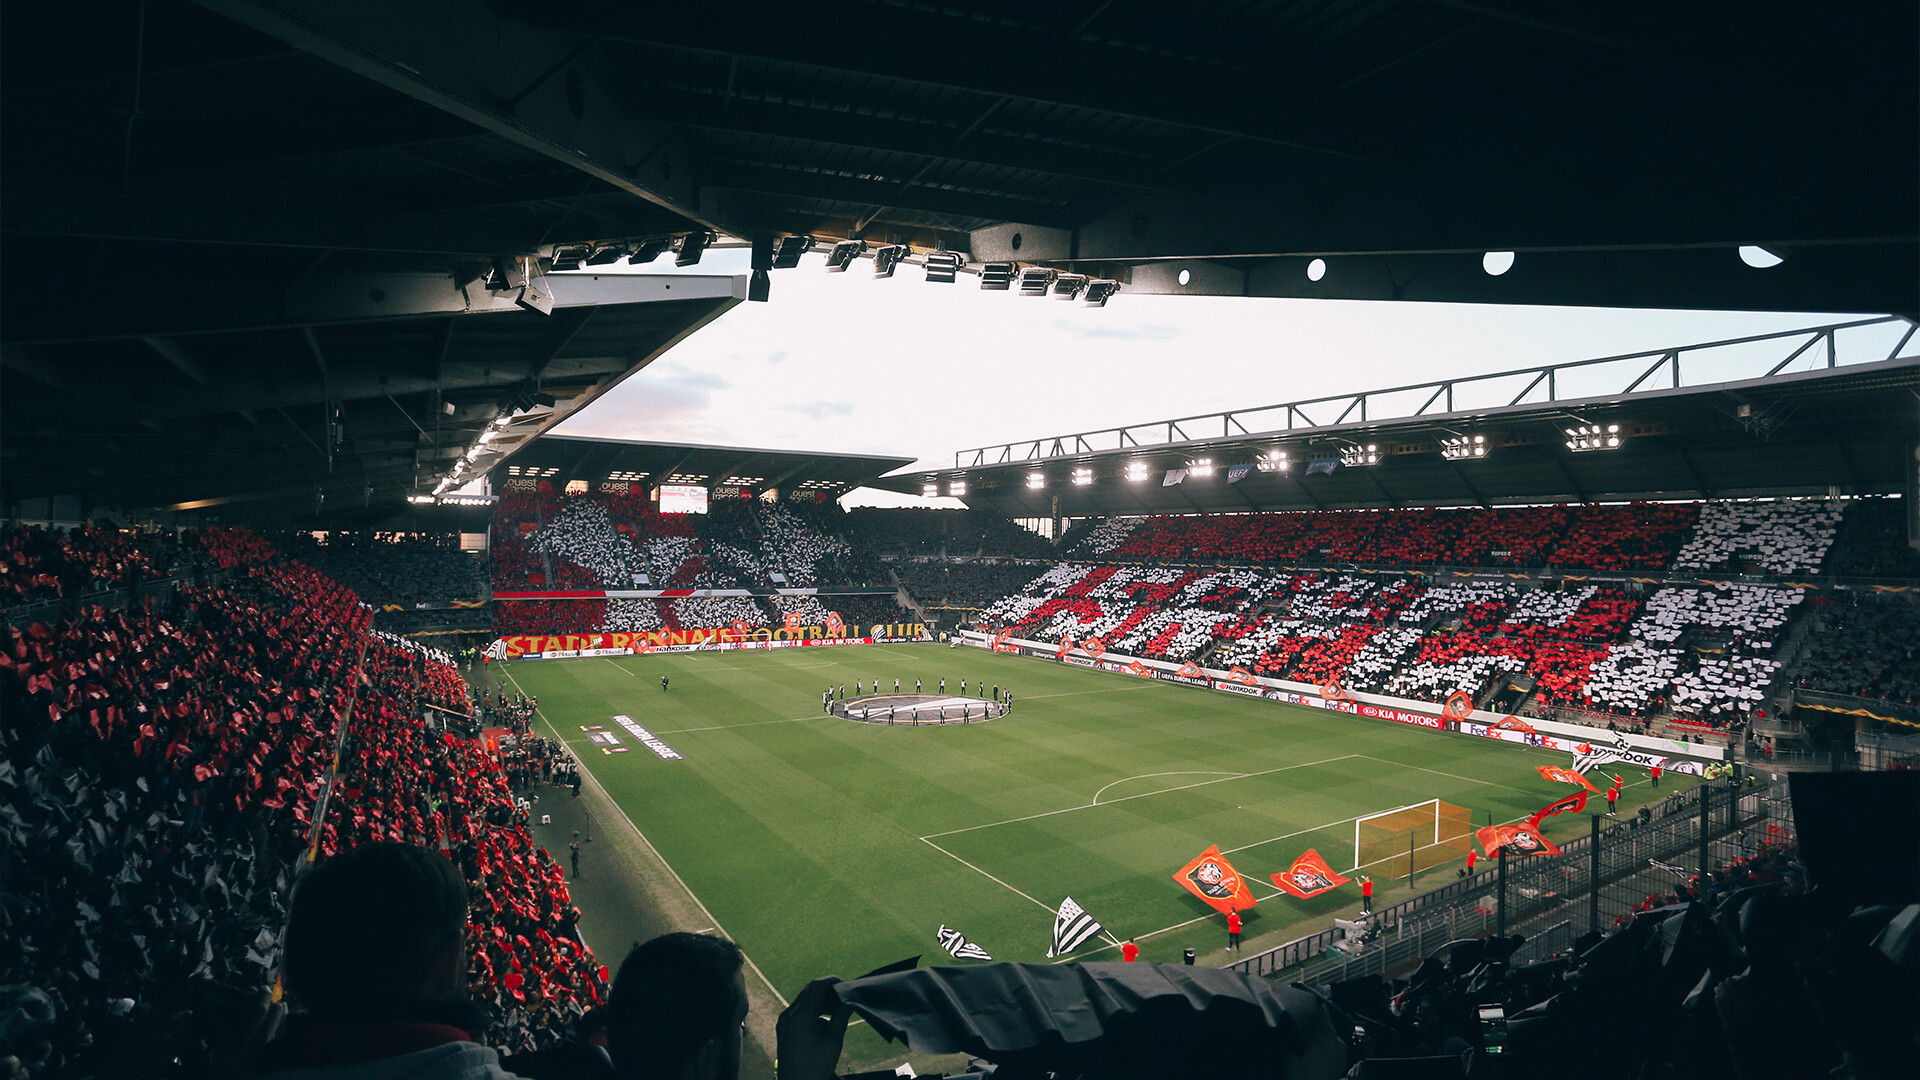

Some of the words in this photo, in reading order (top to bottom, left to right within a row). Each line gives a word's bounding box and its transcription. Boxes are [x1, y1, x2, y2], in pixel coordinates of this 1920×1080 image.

[507, 478, 537, 487] ouest
[601, 481, 629, 491] ouest
[715, 486, 740, 495] ouest
[792, 490, 815, 499] ouest
[821, 636, 834, 646] KIA
[835, 635, 865, 645] MOTORS
[1161, 673, 1174, 681] UEFA
[1173, 674, 1192, 684] EUROPA
[1191, 677, 1209, 687] LEAGU
[1288, 693, 1311, 706] FedEx
[1325, 699, 1349, 712] FedEx
[1378, 709, 1395, 720] KIA
[1397, 712, 1439, 728] MOTORS
[1470, 723, 1502, 740] FedEx
